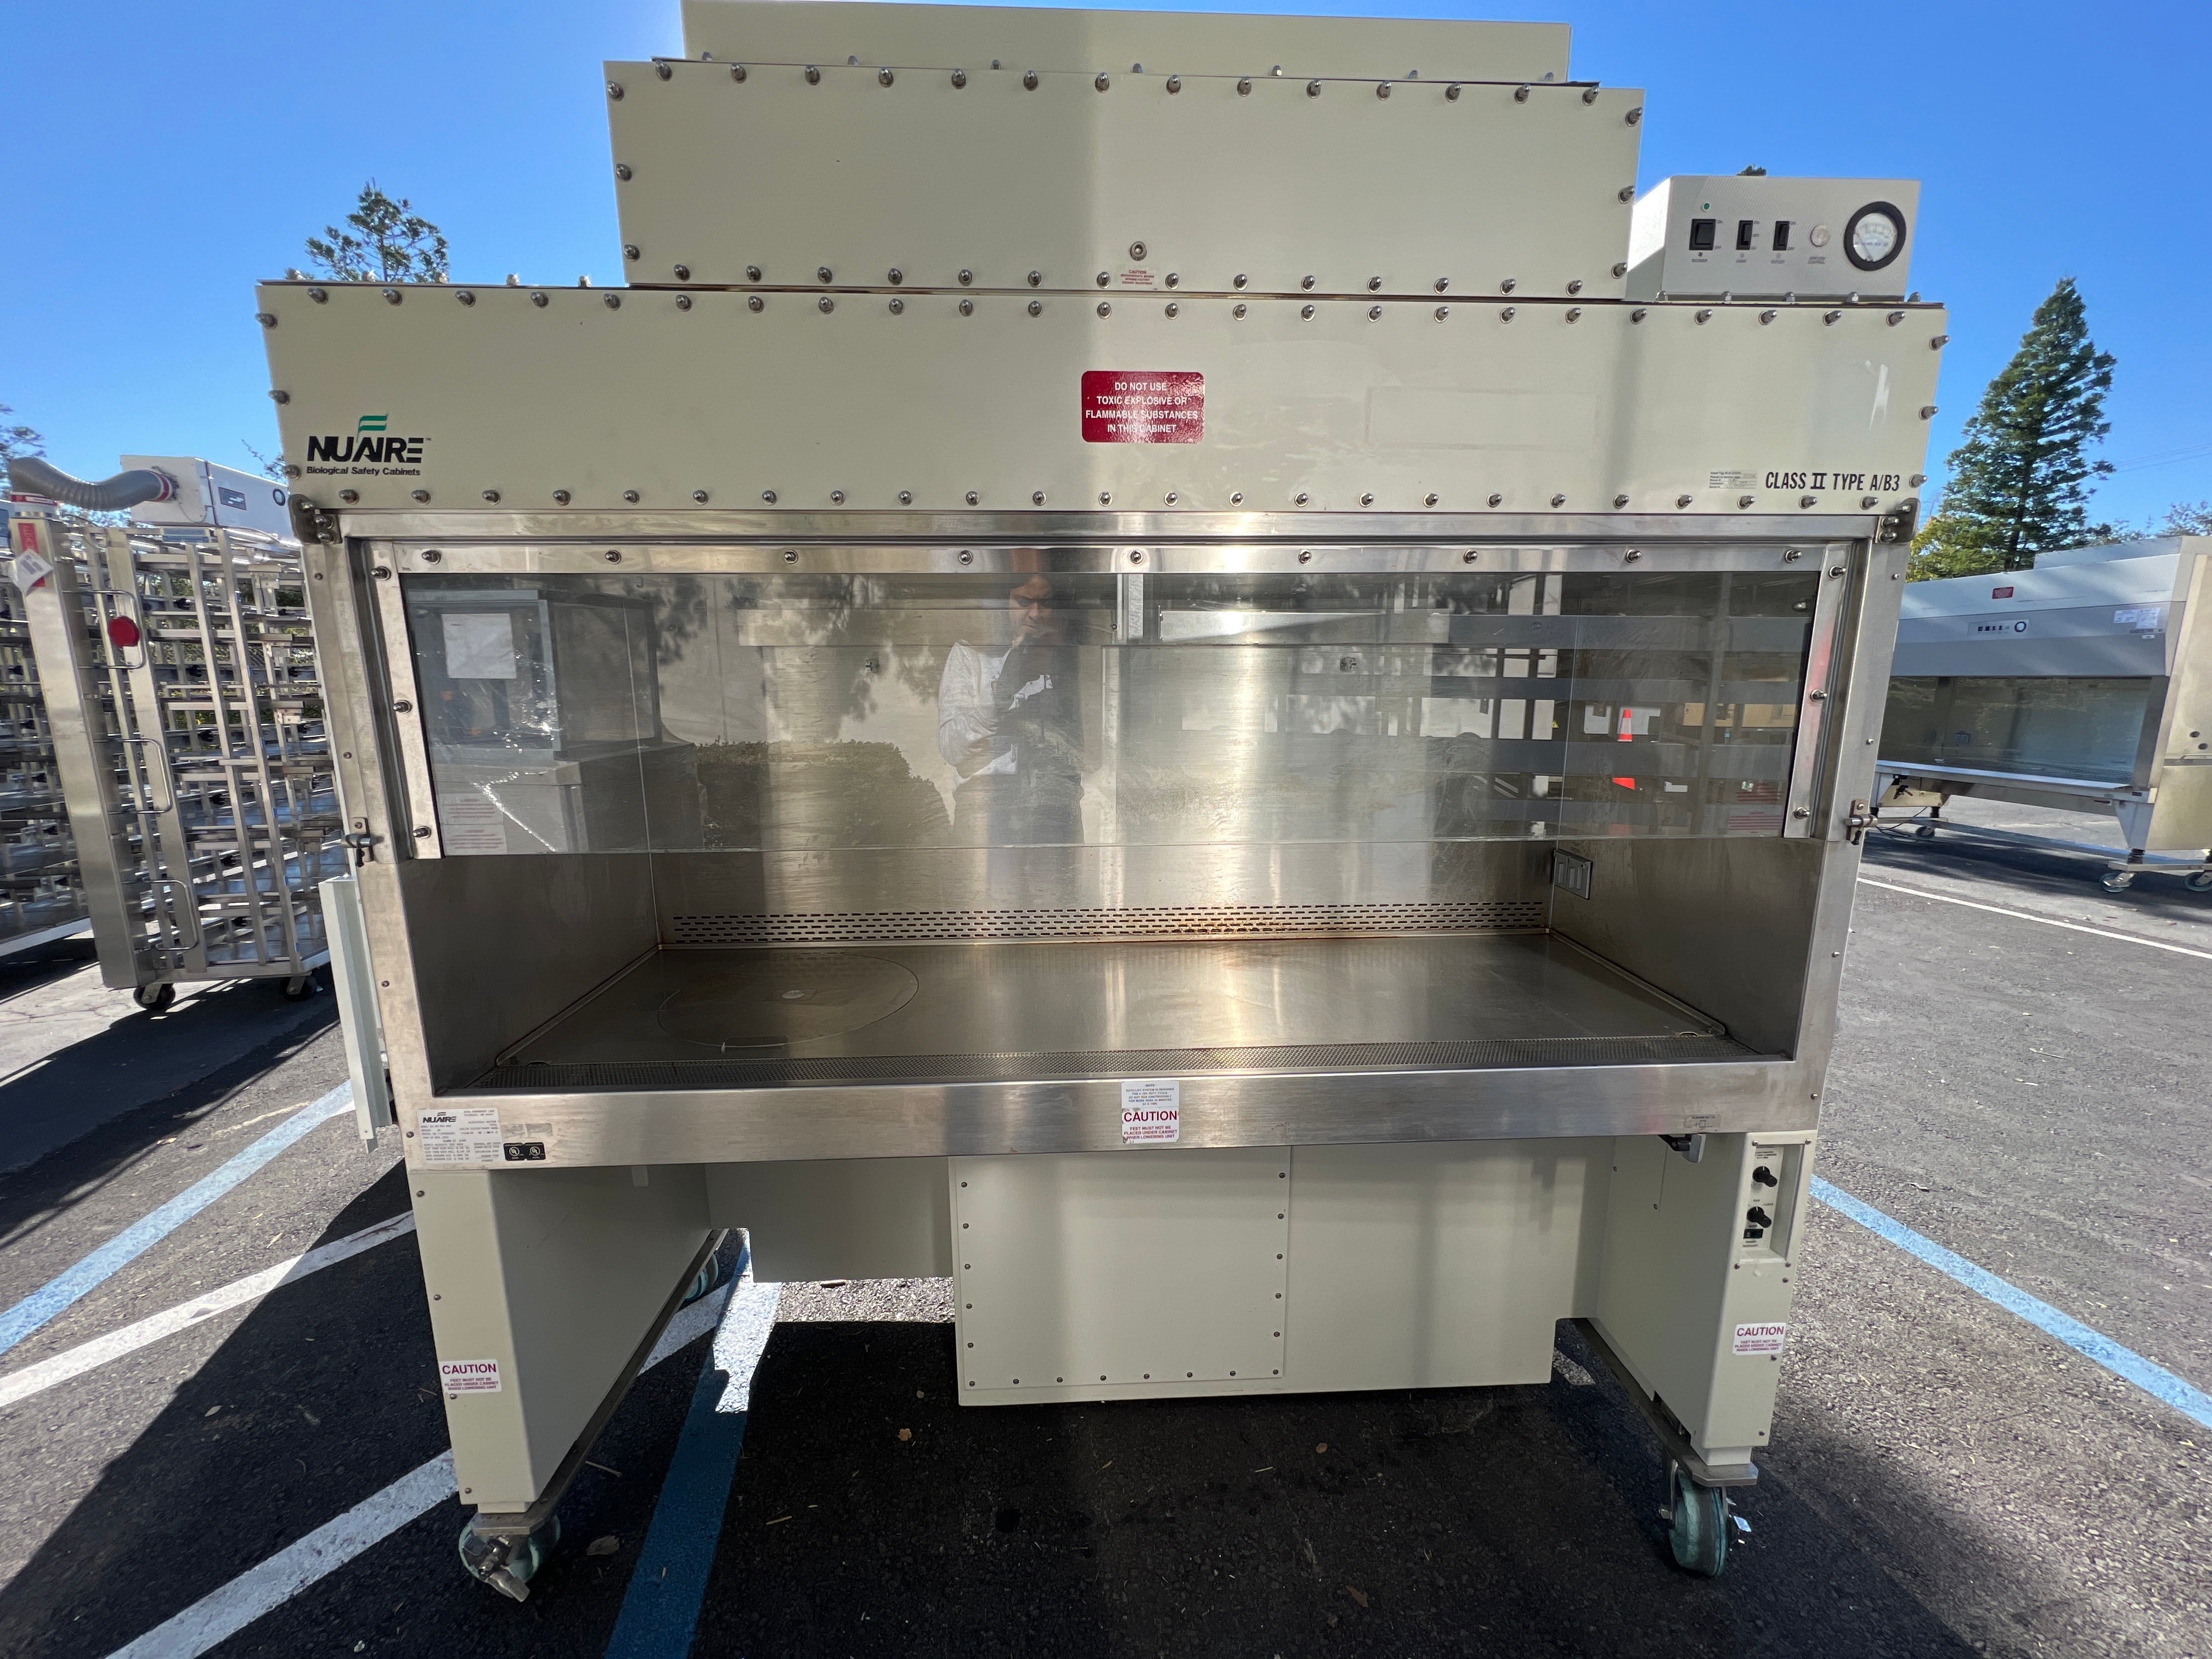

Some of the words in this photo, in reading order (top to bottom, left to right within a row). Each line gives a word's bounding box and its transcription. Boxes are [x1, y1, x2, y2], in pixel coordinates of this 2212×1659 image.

[1115, 382, 1127, 391] DO
[1130, 382, 1147, 391] NOT
[1150, 382, 1167, 391] USE
[1097, 396, 1122, 404] TOXIC
[1125, 396, 1172, 405] EXPLOSIVE
[1174, 397, 1187, 405] OR
[1086, 410, 1138, 419] FLAMMABLE
[1141, 411, 1198, 419] SUBSTANCES
[1107, 424, 1116, 432] IN
[1119, 424, 1138, 432] THIS
[1140, 425, 1177, 433] CABINET
[307, 436, 424, 463] NUAIRE
[307, 466, 348, 475] Biological
[351, 467, 380, 476] Safety
[382, 467, 420, 476] Cabinets
[1765, 472, 1807, 489] CLASS
[1833, 473, 1865, 490] TYPE
[1870, 474, 1900, 491] A/B3
[1124, 1110, 1177, 1122] CAUTION
[1737, 1326, 1785, 1336] CAUTION
[442, 1364, 496, 1374] CAUTION
